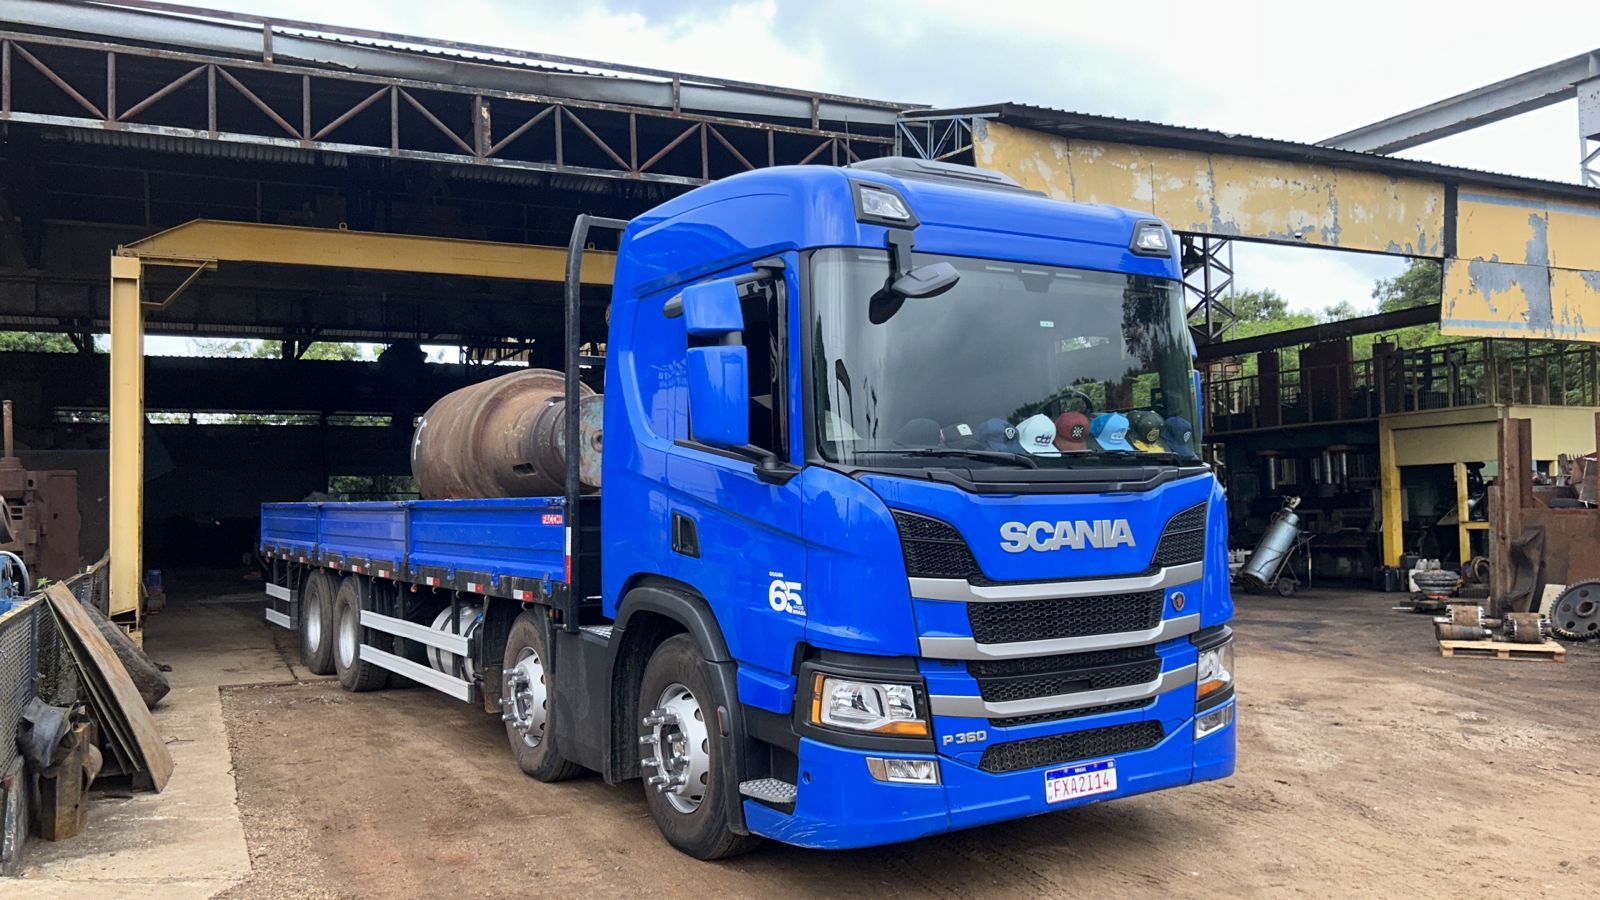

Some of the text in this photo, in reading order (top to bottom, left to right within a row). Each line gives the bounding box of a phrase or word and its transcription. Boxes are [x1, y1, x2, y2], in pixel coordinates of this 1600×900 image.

[1000, 519, 1136, 553] SCANIA
[769, 580, 802, 614] 65
[943, 730, 987, 746] P 360
[1054, 772, 1110, 798] FXA2I14
